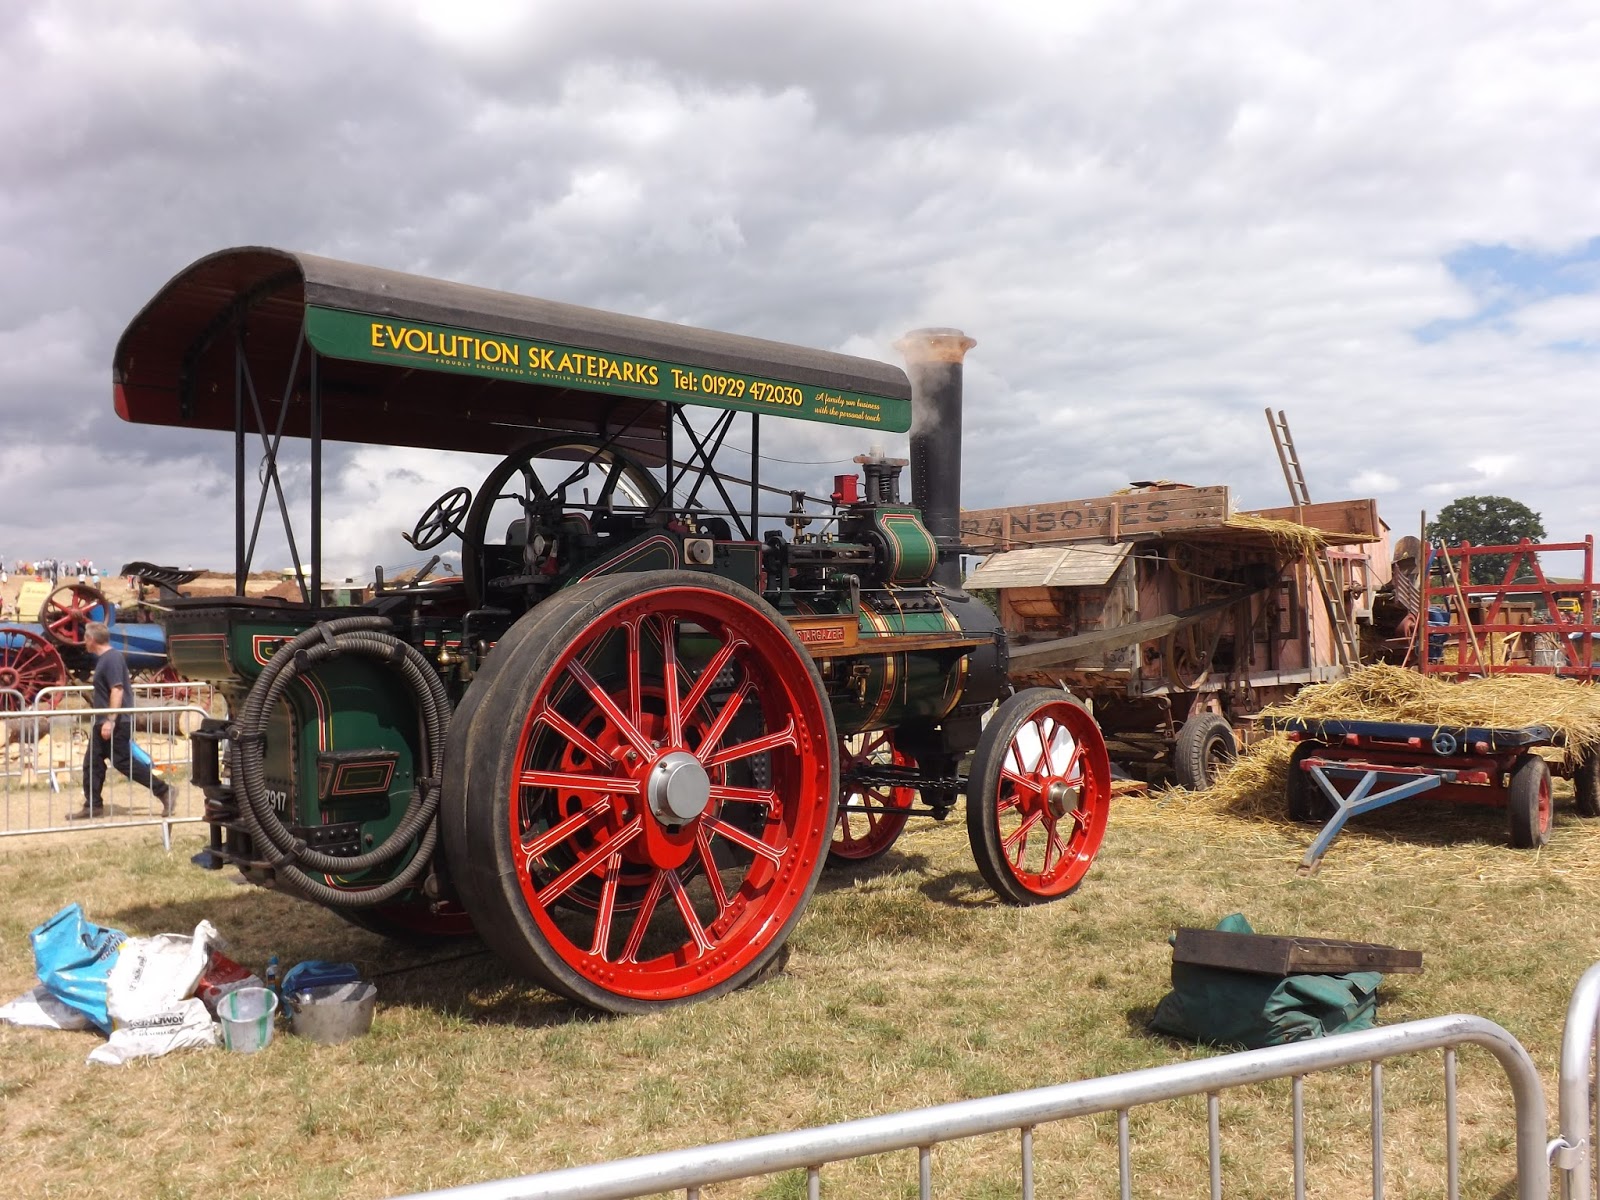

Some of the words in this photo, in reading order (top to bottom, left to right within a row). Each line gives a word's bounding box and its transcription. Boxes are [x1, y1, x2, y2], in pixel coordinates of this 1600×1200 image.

[371, 323, 519, 366] EVOLUTION
[529, 347, 660, 386] SKATEPARKS
[435, 358, 471, 367] PROUDLY
[476, 364, 524, 375] ENGINEERED
[542, 373, 571, 381] BRITISH
[575, 377, 611, 387] STANDARD
[671, 369, 698, 391] Tel:
[702, 374, 745, 398] 01929
[749, 382, 803, 406] 472030
[815, 392, 825, 401] A
[824, 393, 845, 408] family
[856, 398, 880, 410] business
[814, 405, 829, 415] with
[829, 406, 839, 416] the
[838, 410, 865, 420] personal
[865, 413, 880, 422] touch
[961, 501, 1169, 538] RANSOMES
[797, 629, 843, 640] STARGAZER
